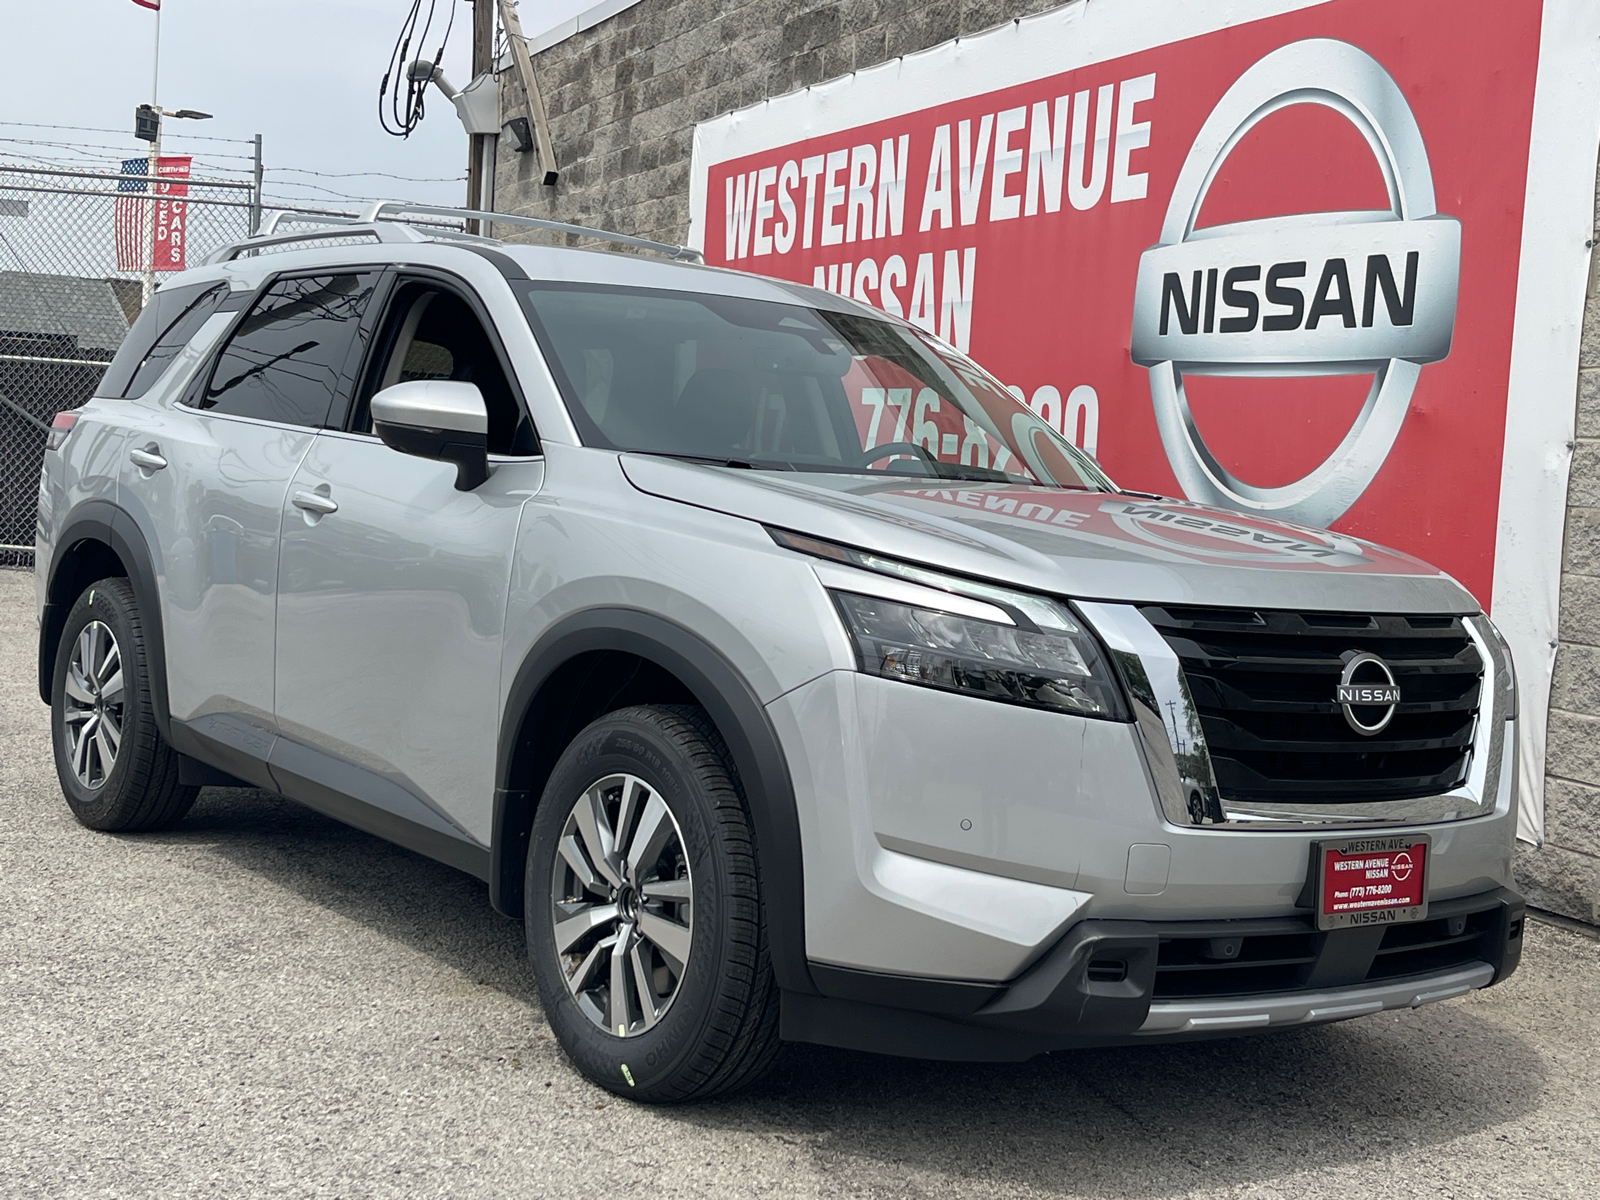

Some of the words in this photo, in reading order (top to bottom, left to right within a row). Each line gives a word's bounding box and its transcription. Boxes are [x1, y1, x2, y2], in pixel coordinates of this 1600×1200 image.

[725, 134, 910, 261] WESTERN
[919, 72, 1156, 232] AVENUE
[158, 182, 170, 240] USED
[171, 201, 183, 262] CARS
[1159, 250, 1419, 336] NISSAN
[1339, 689, 1400, 701] NISSAN
[1348, 840, 1385, 852] WESTERN
[1388, 839, 1404, 849] AVE
[1334, 860, 1363, 871] WESTERN
[1365, 858, 1389, 868] AVENUE
[1365, 869, 1389, 879] NISSAN
[1349, 886, 1365, 899] (773)
[1365, 884, 1392, 896] 776-8200
[1333, 898, 1410, 909] www.westernavenissan.com
[1350, 910, 1395, 924] NISSAN
